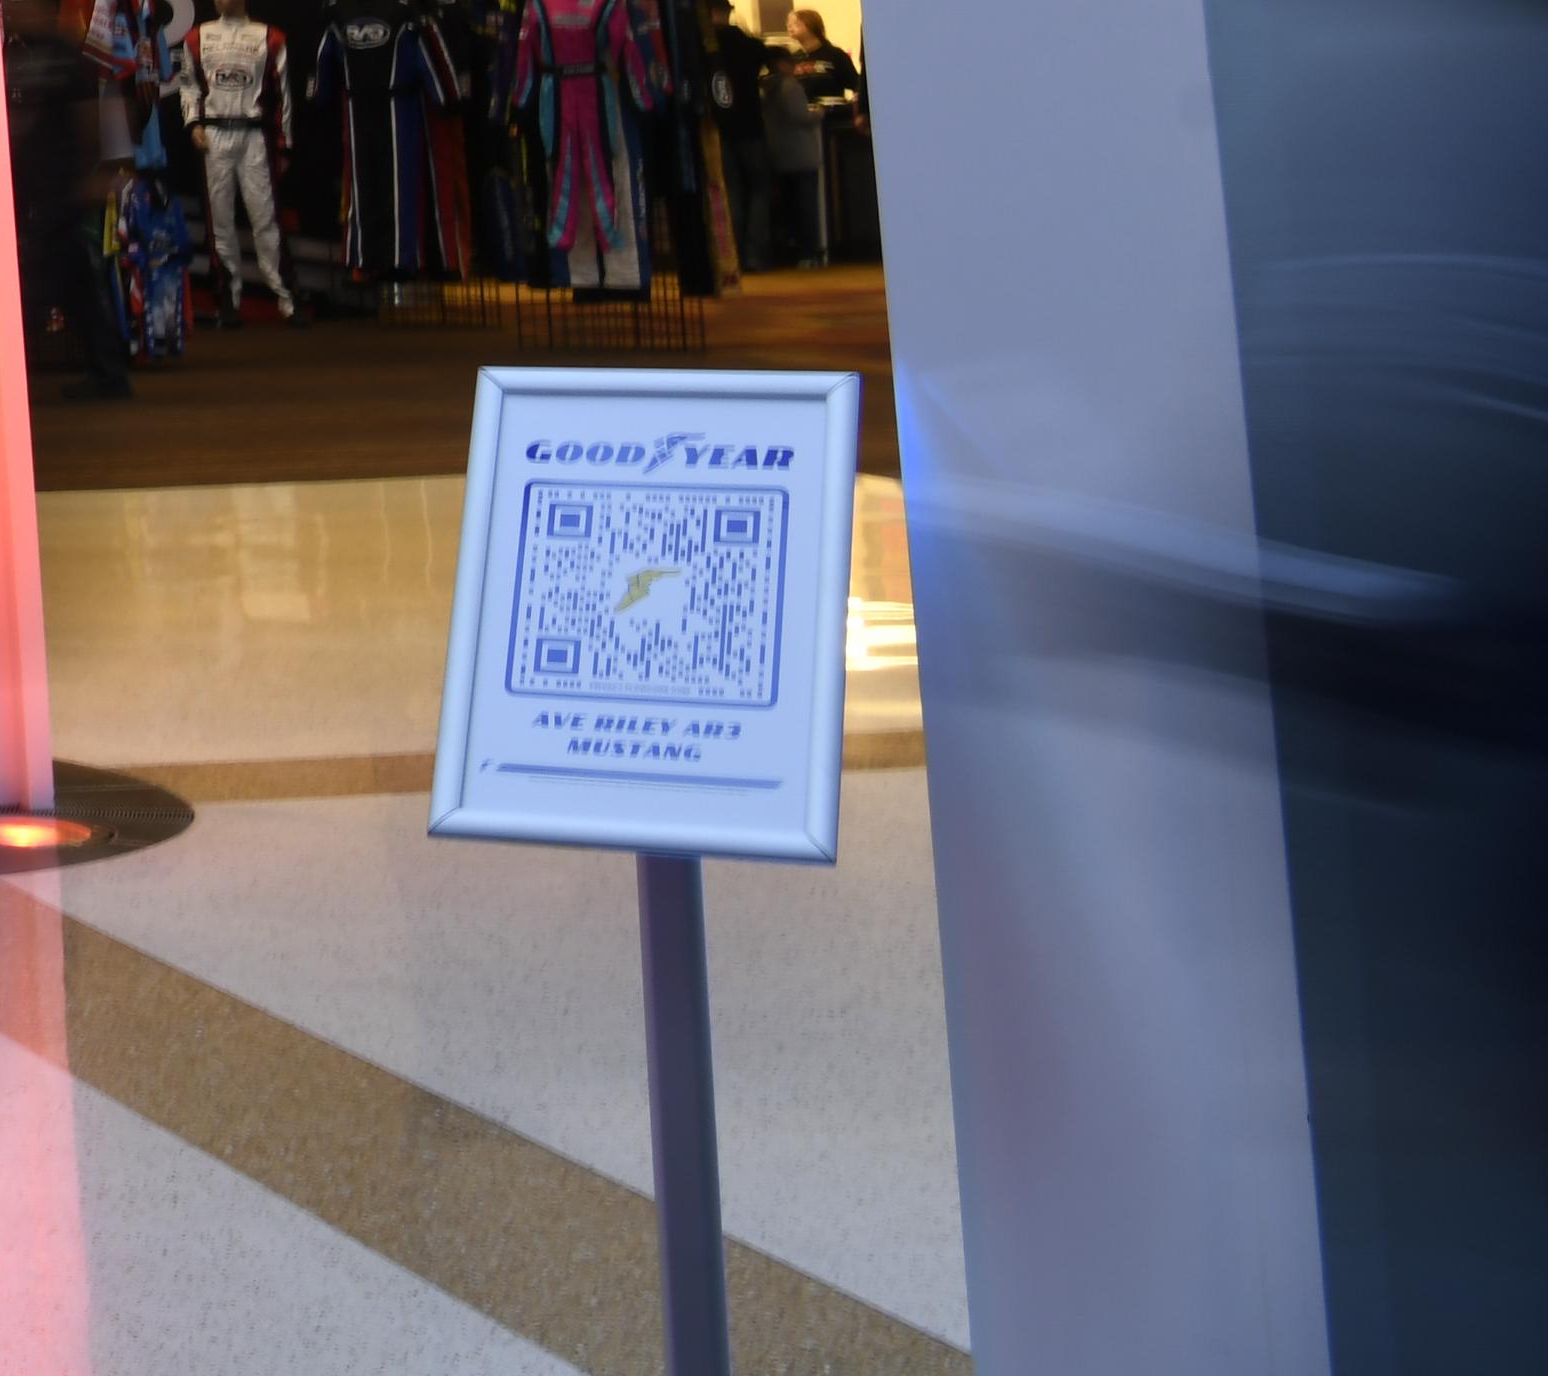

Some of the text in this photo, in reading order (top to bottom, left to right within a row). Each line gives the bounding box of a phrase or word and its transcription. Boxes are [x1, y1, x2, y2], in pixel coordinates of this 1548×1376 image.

[525, 431, 795, 474] GOODYEAR
[593, 714, 678, 736] RILEY
[567, 736, 703, 763] MUSTANG
